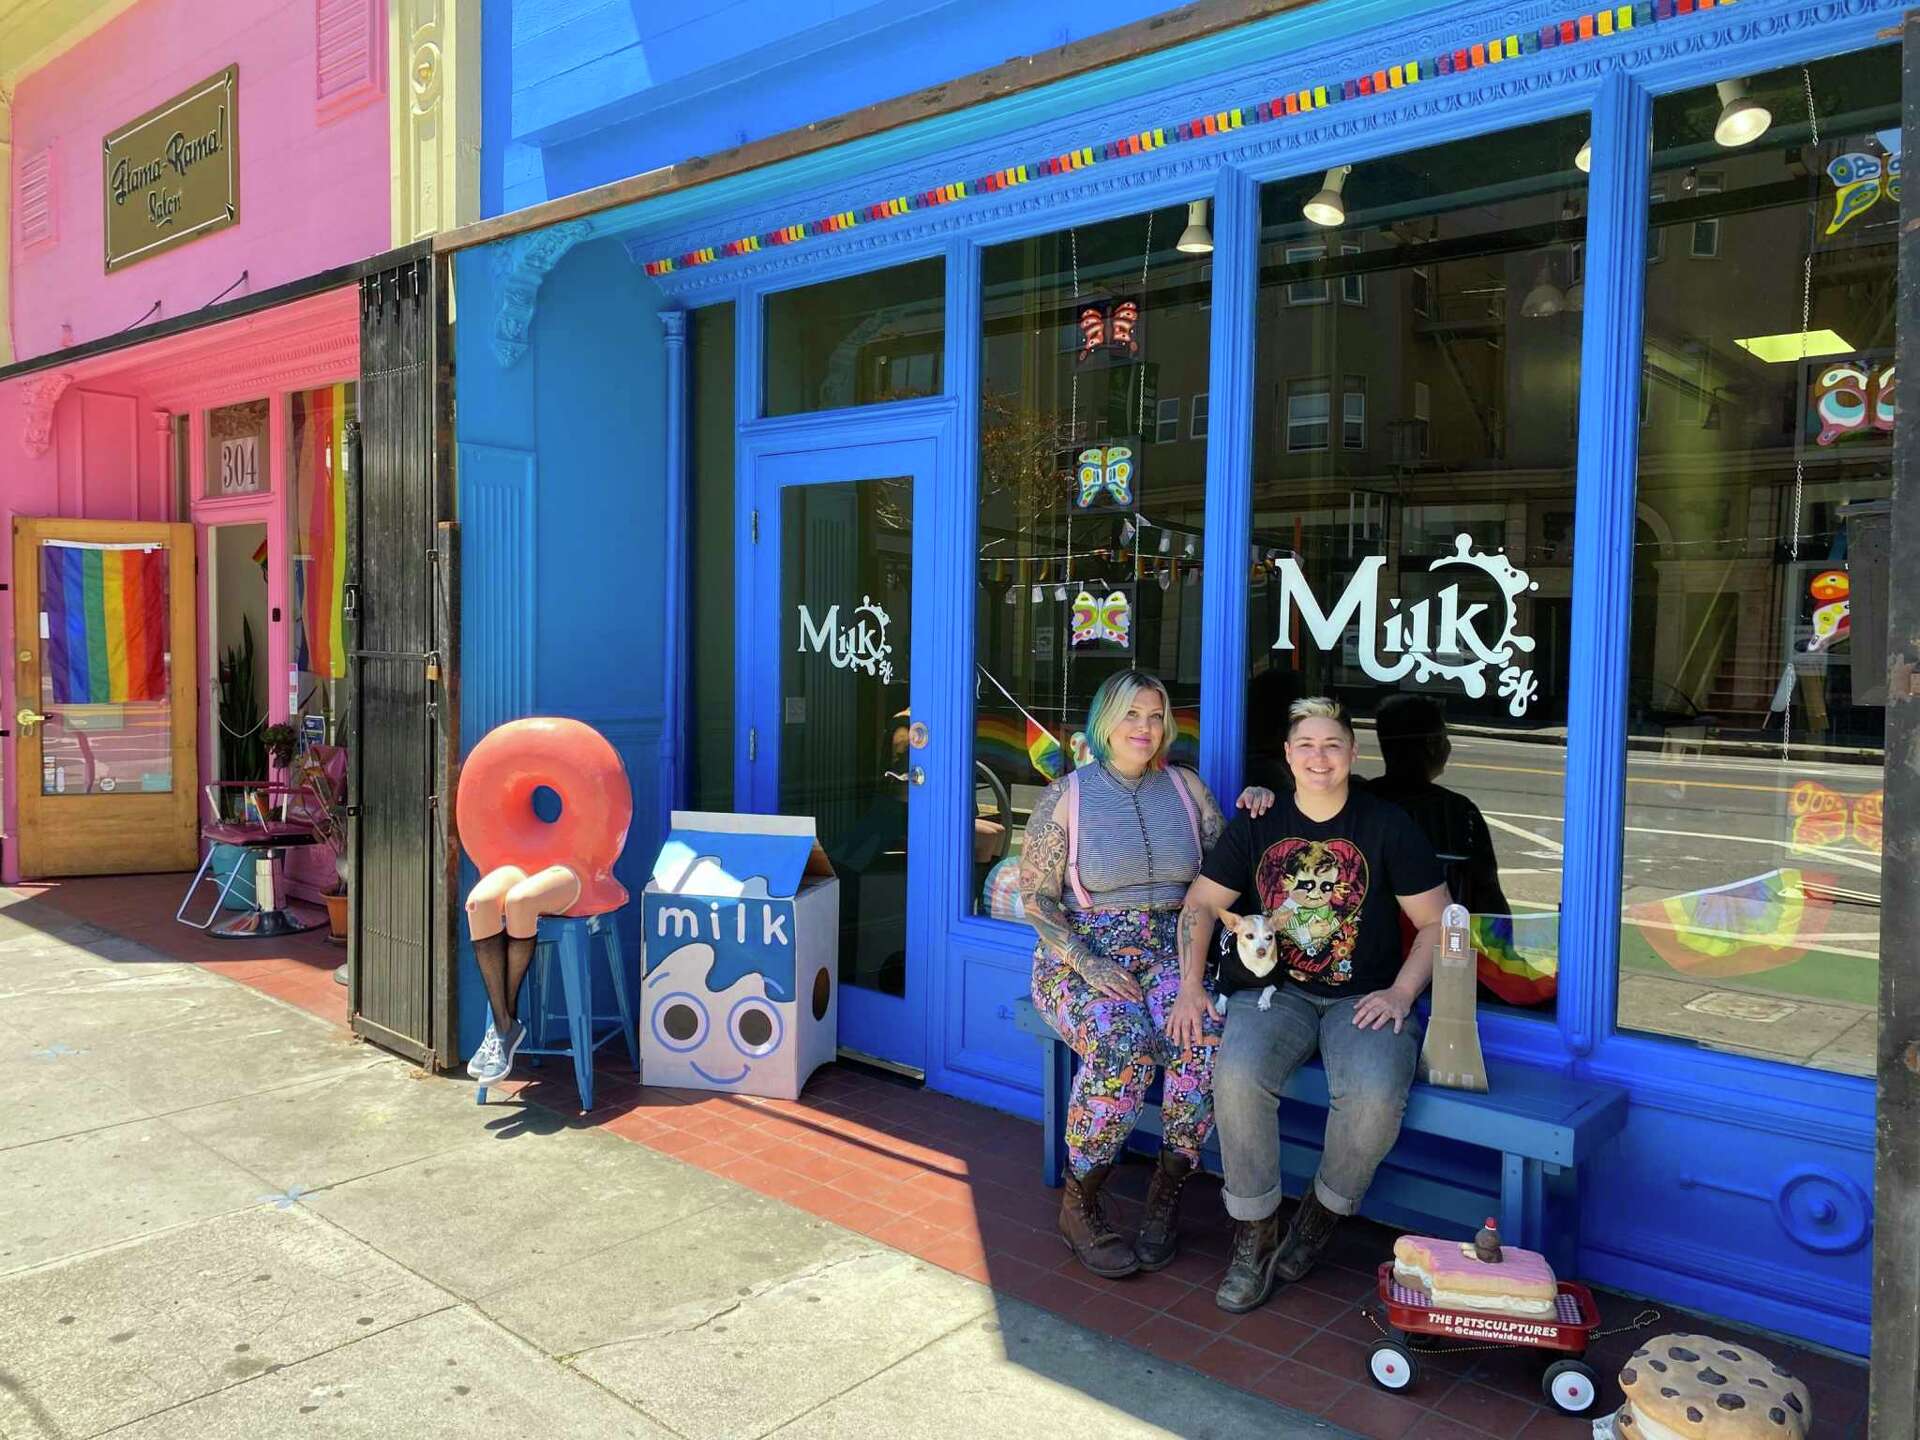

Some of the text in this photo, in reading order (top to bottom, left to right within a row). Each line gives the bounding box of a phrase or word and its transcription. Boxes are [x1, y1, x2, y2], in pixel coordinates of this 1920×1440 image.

[111, 105, 224, 206] Glama-Rama!
[147, 187, 182, 227] Salon
[223, 444, 257, 488] 304
[797, 605, 885, 669] Milk
[1271, 555, 1514, 683] Milk
[658, 902, 788, 945] milk
[1428, 1313, 1558, 1337] THE PETSCULPTURES
